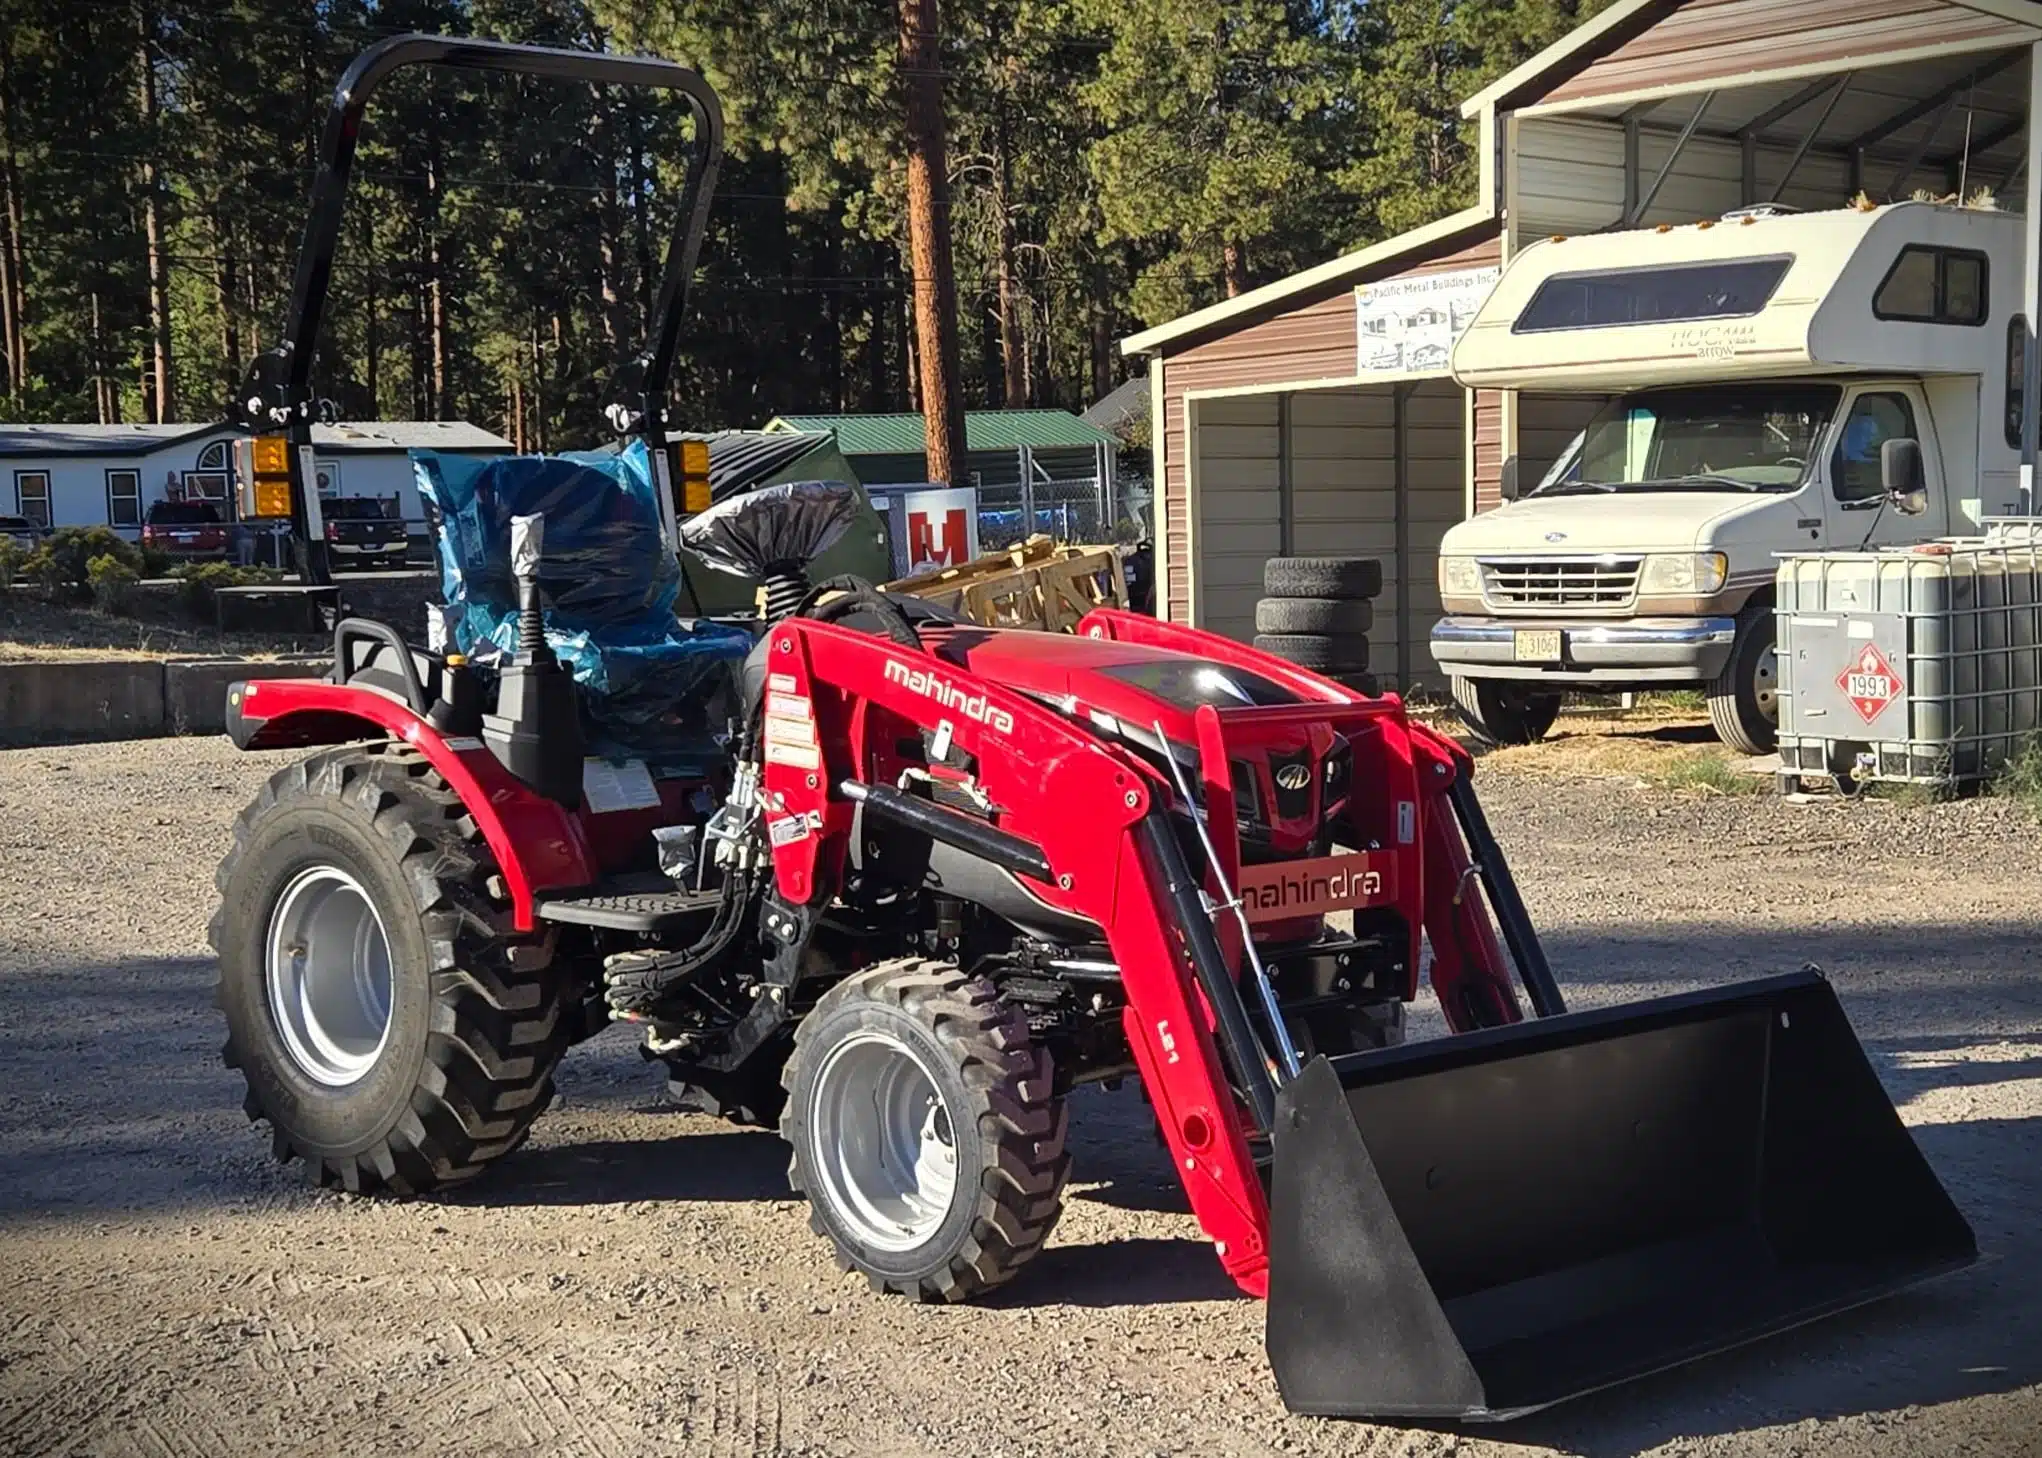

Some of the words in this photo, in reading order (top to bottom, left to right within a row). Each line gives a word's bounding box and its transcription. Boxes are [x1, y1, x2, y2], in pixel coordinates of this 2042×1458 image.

[1373, 284, 1400, 298] Pacific
[1403, 281, 1429, 294] Metal
[1432, 276, 1474, 290] Buildings
[884, 659, 1014, 735] mahindra
[1852, 675, 1887, 697] 1993
[1863, 700, 1873, 713] 3
